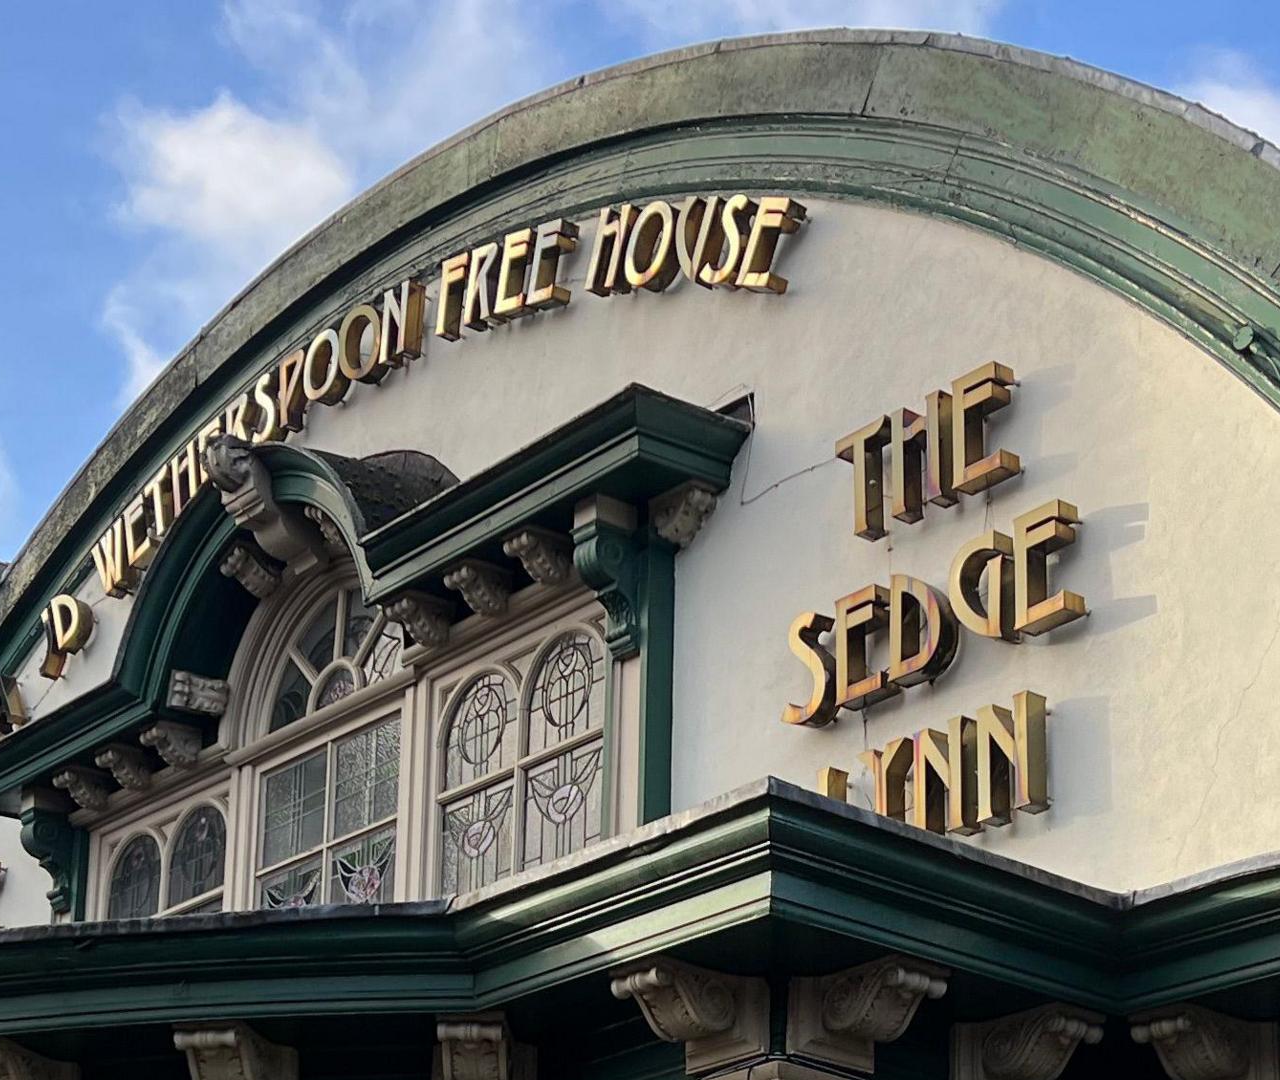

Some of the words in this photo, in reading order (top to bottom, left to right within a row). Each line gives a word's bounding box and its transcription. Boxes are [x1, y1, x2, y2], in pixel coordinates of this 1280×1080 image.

[435, 218, 580, 342] FREE
[585, 194, 807, 298] HOUSE
[836, 361, 1021, 543] THE
[781, 499, 1088, 729] SEDGE
